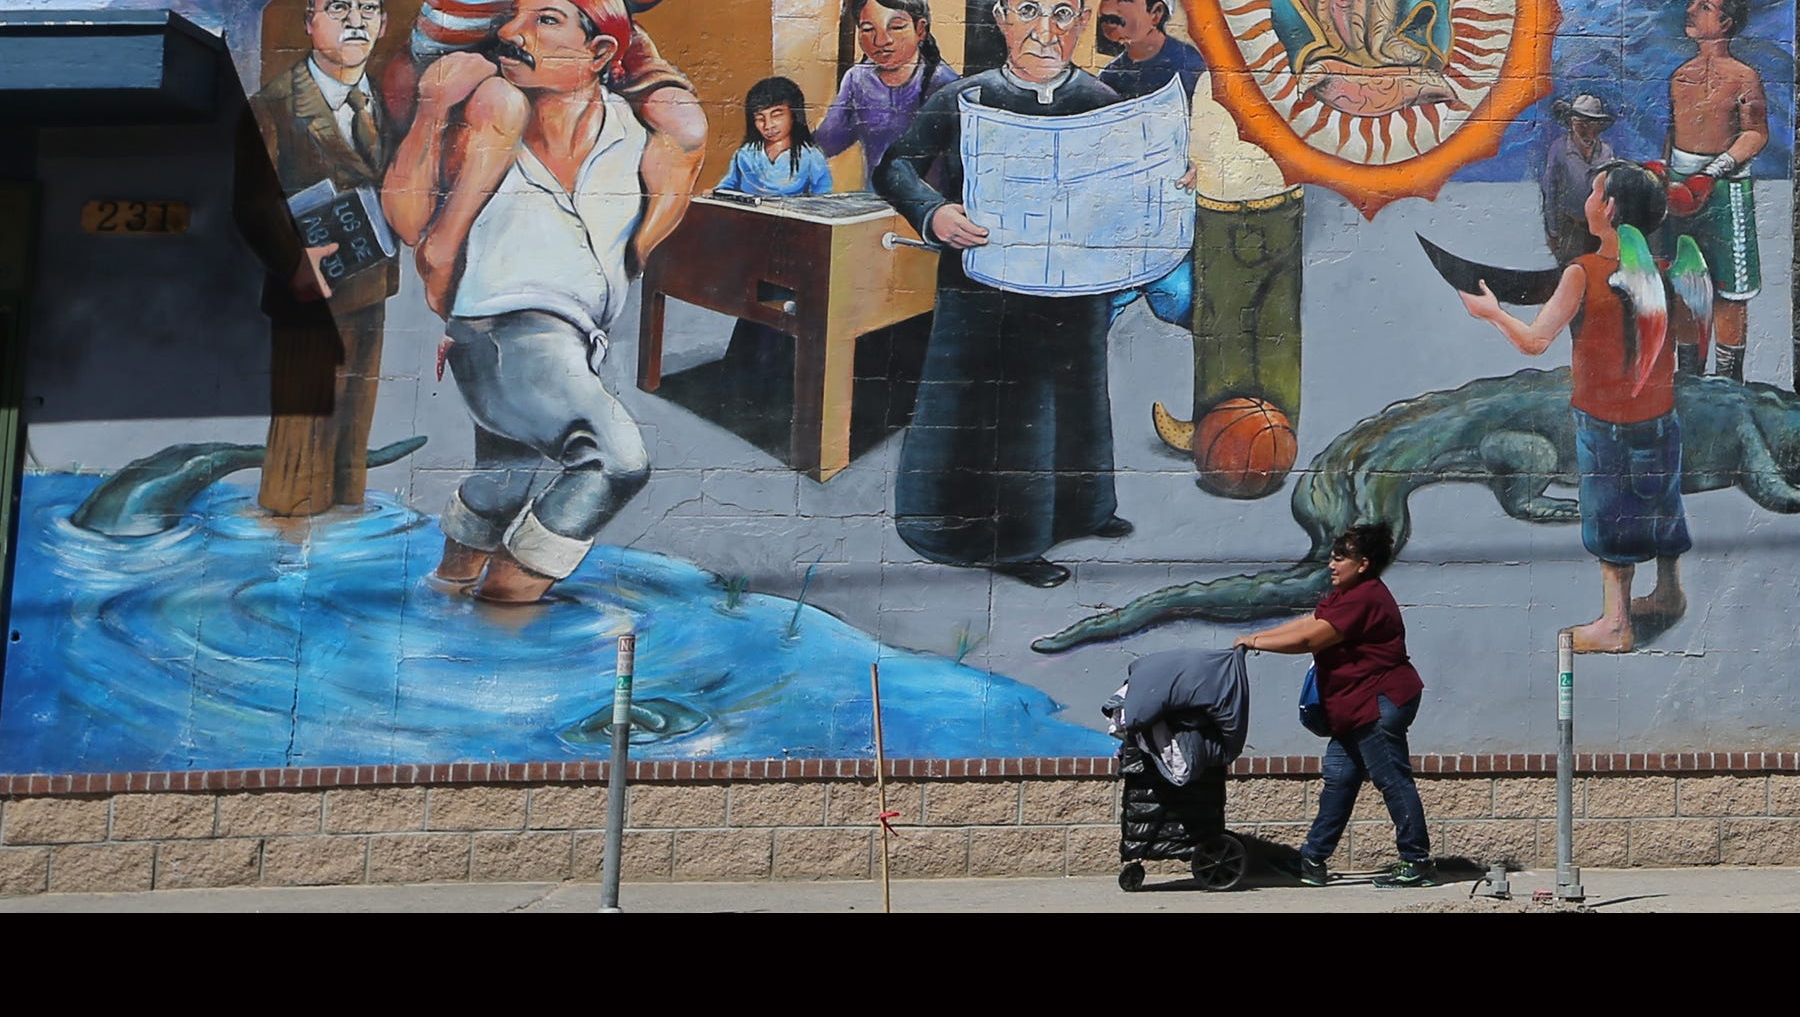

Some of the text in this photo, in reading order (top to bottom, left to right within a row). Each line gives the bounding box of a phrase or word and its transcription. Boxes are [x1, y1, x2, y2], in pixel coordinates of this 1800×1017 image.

[96, 202, 169, 232] 231
[302, 216, 345, 278] ABJO
[333, 202, 374, 263] LOS DE
[617, 677, 625, 689] 2
[1561, 674, 1568, 686] 2
